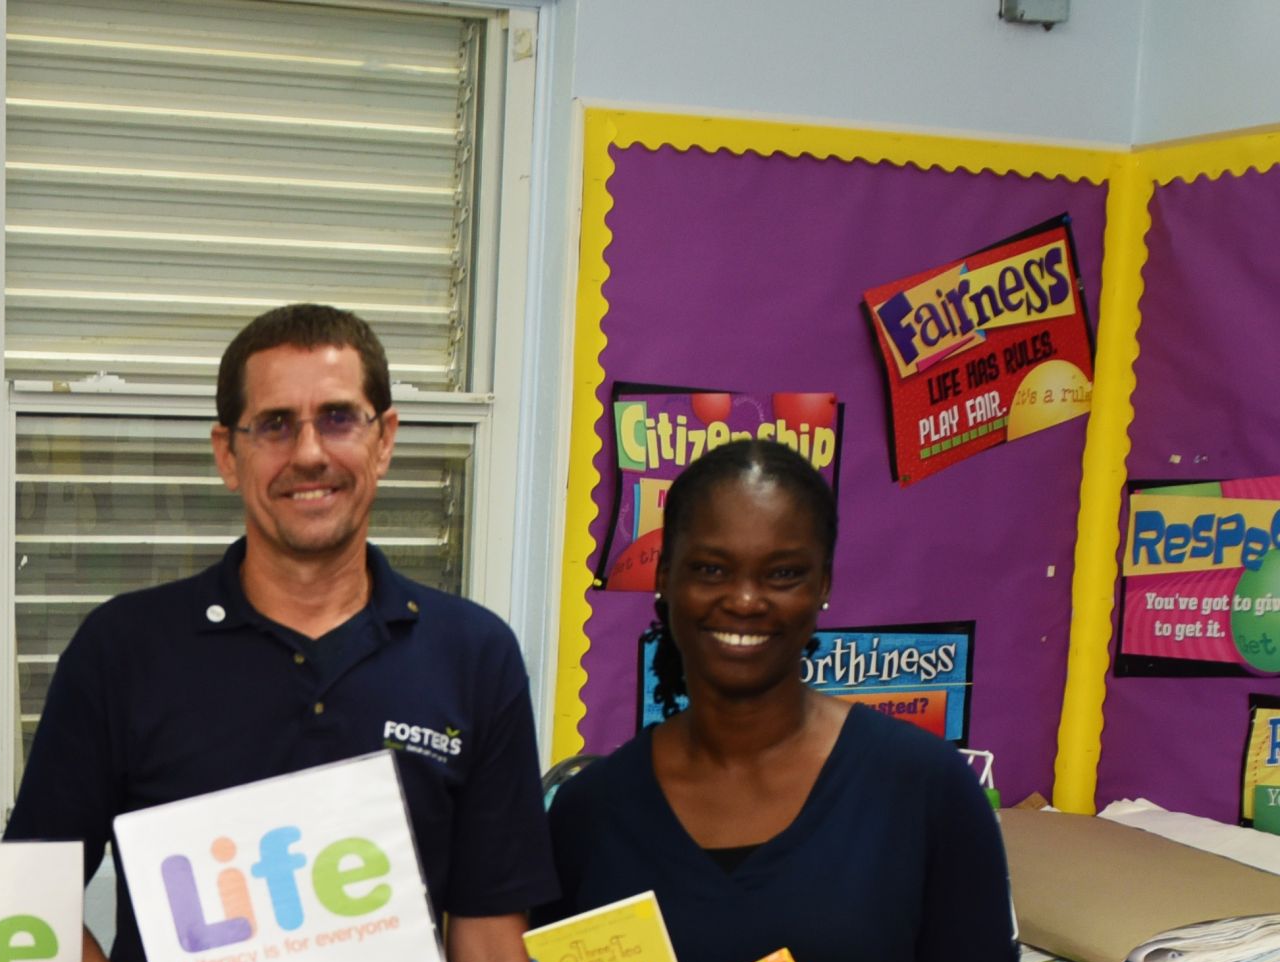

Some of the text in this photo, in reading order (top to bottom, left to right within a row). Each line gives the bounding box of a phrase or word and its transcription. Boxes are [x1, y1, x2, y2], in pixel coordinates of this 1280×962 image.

[876, 247, 1069, 366] Fairness
[928, 330, 1058, 405] LIFE HAS RULES.
[919, 390, 1008, 445] PLAY FAIR.
[1043, 391, 1054, 403] a
[1145, 592, 1198, 611] You've
[1201, 594, 1231, 616] got
[1234, 594, 1251, 611] to
[1155, 620, 1226, 641] to get it.
[871, 697, 930, 717] sted?
[160, 825, 392, 954] Life
[263, 944, 280, 960] is
[283, 934, 309, 954] for
[315, 914, 400, 947] everyone
